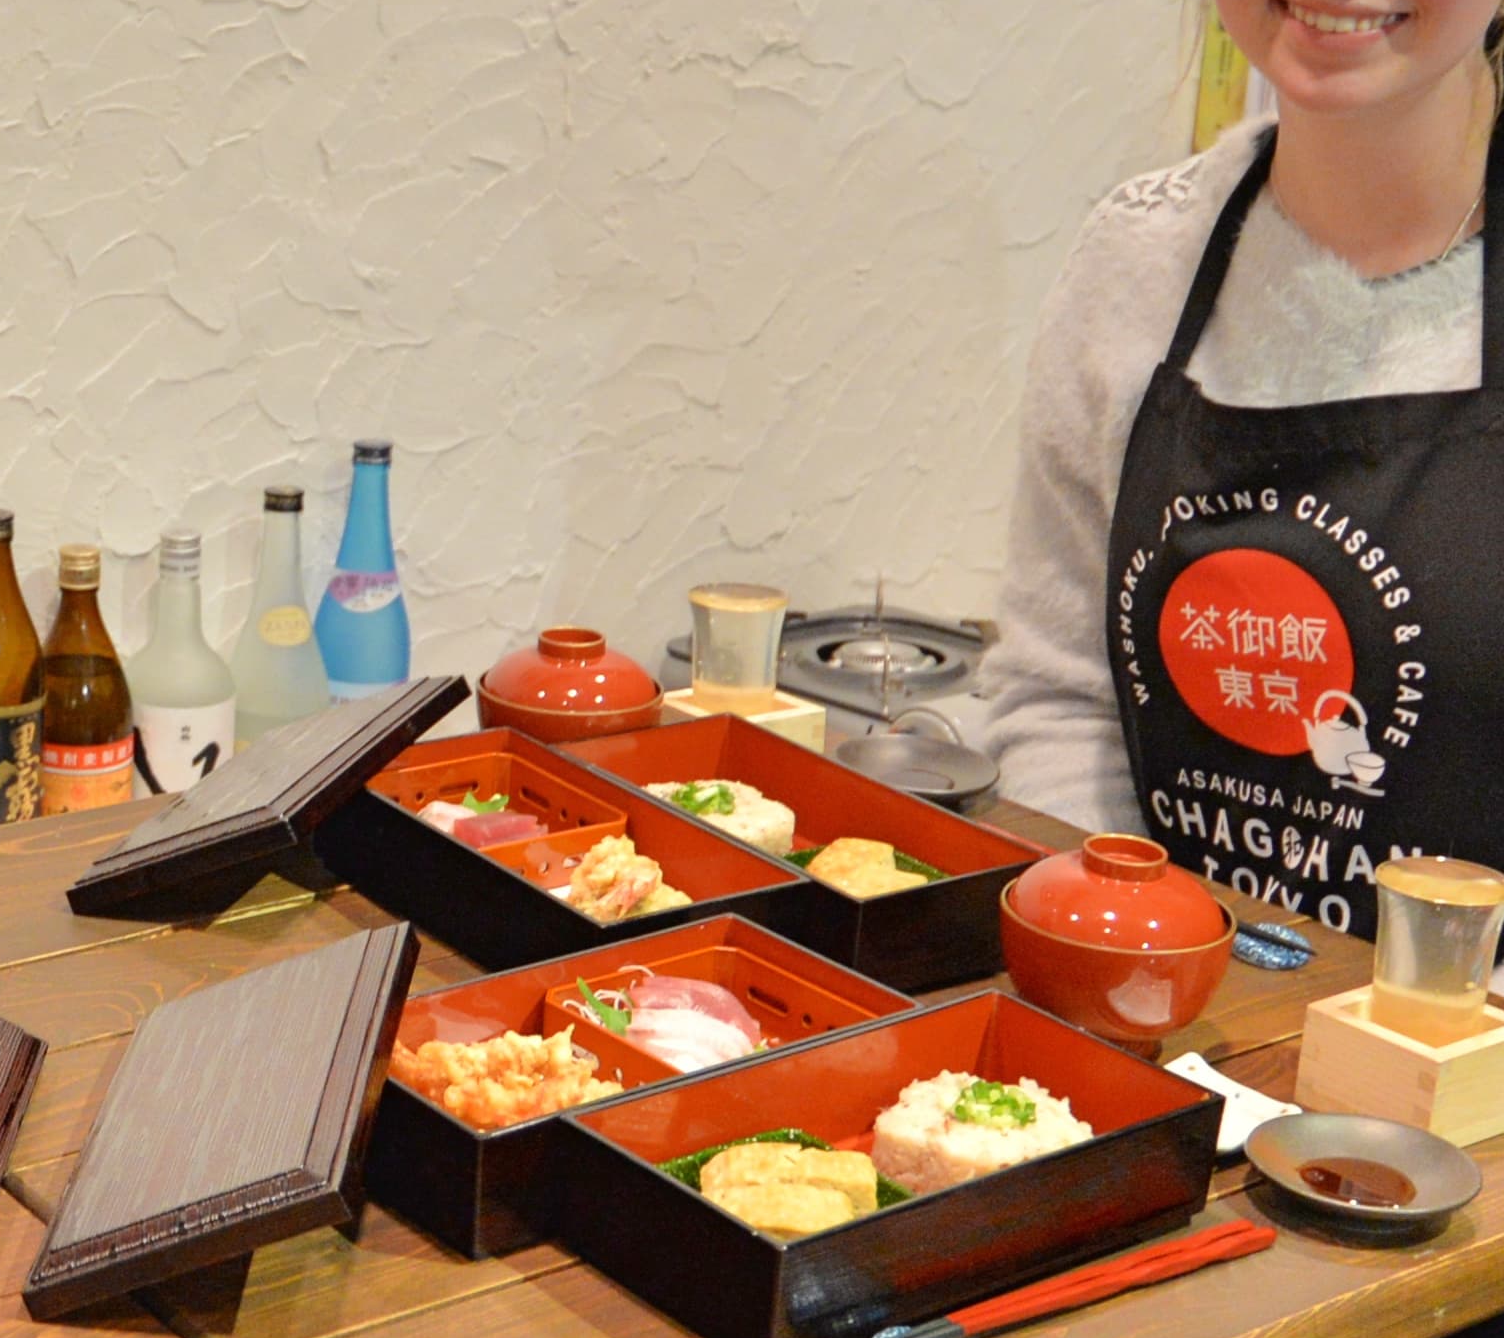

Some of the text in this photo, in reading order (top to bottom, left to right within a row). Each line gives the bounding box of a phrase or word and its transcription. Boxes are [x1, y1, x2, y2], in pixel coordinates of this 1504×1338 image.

[1295, 494, 1411, 610] CLASSES
[1119, 548, 1154, 706] WASHOKU,
[1179, 601, 1329, 664] 茶御飯
[1394, 624, 1422, 644] &
[1214, 664, 1300, 716] 東京
[1383, 662, 1426, 749] CAFE
[1176, 767, 1364, 830] ASAKUSA JAPAN
